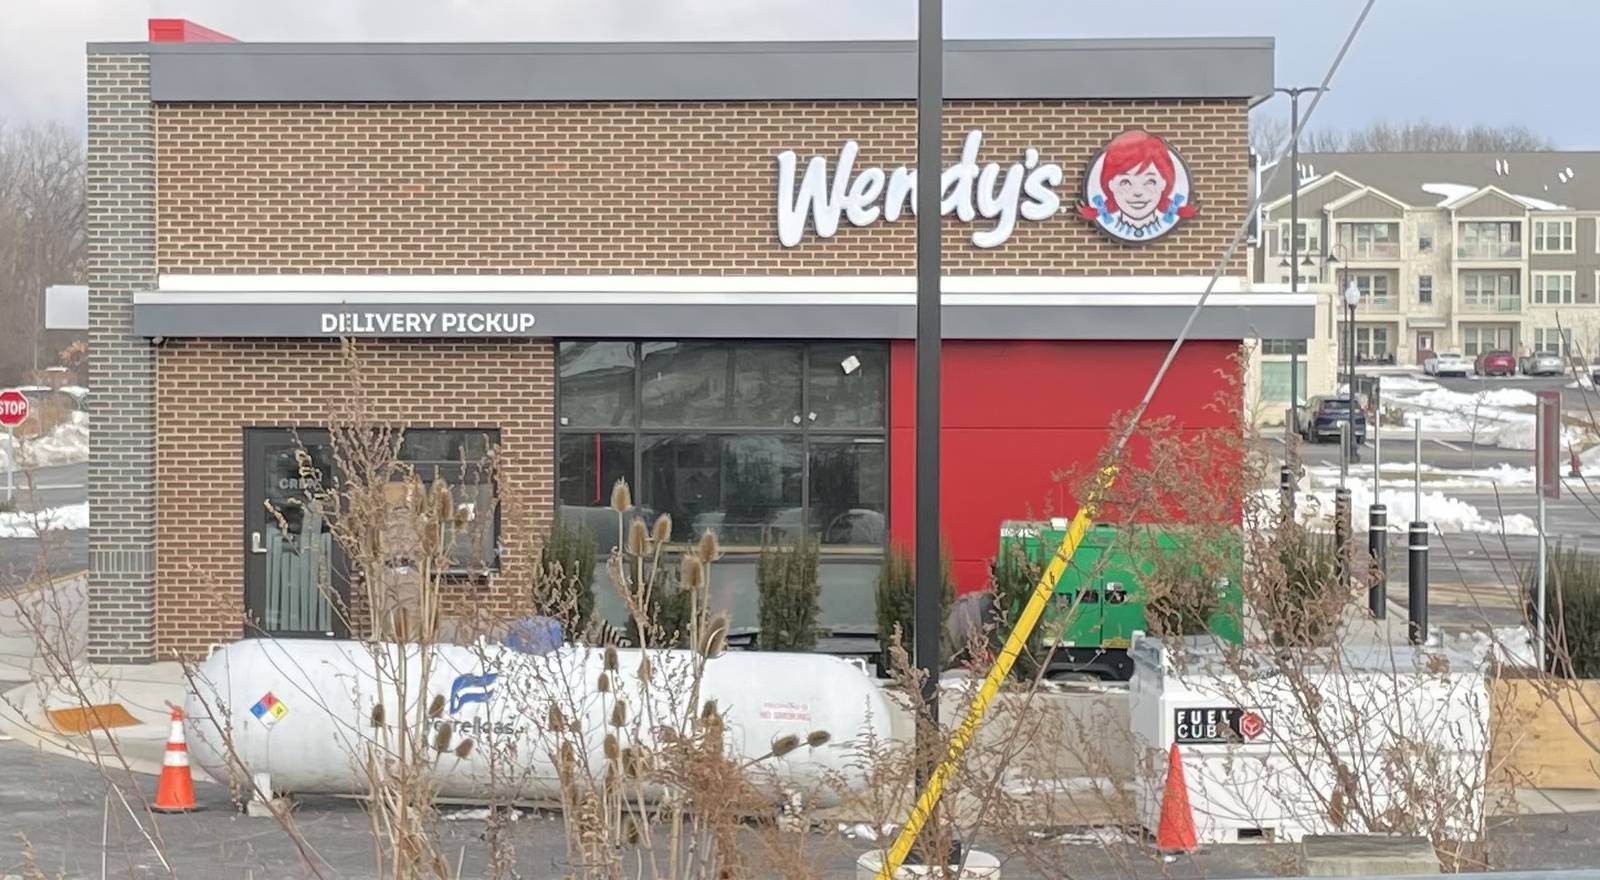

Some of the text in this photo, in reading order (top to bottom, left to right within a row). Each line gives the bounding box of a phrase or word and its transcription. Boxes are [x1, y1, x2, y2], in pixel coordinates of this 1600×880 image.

[777, 129, 1063, 248] Wendy's
[321, 313, 535, 333] DELIVERY PICKUP
[1177, 709, 1230, 725] FUEL
[1177, 725, 1223, 738] CUB
